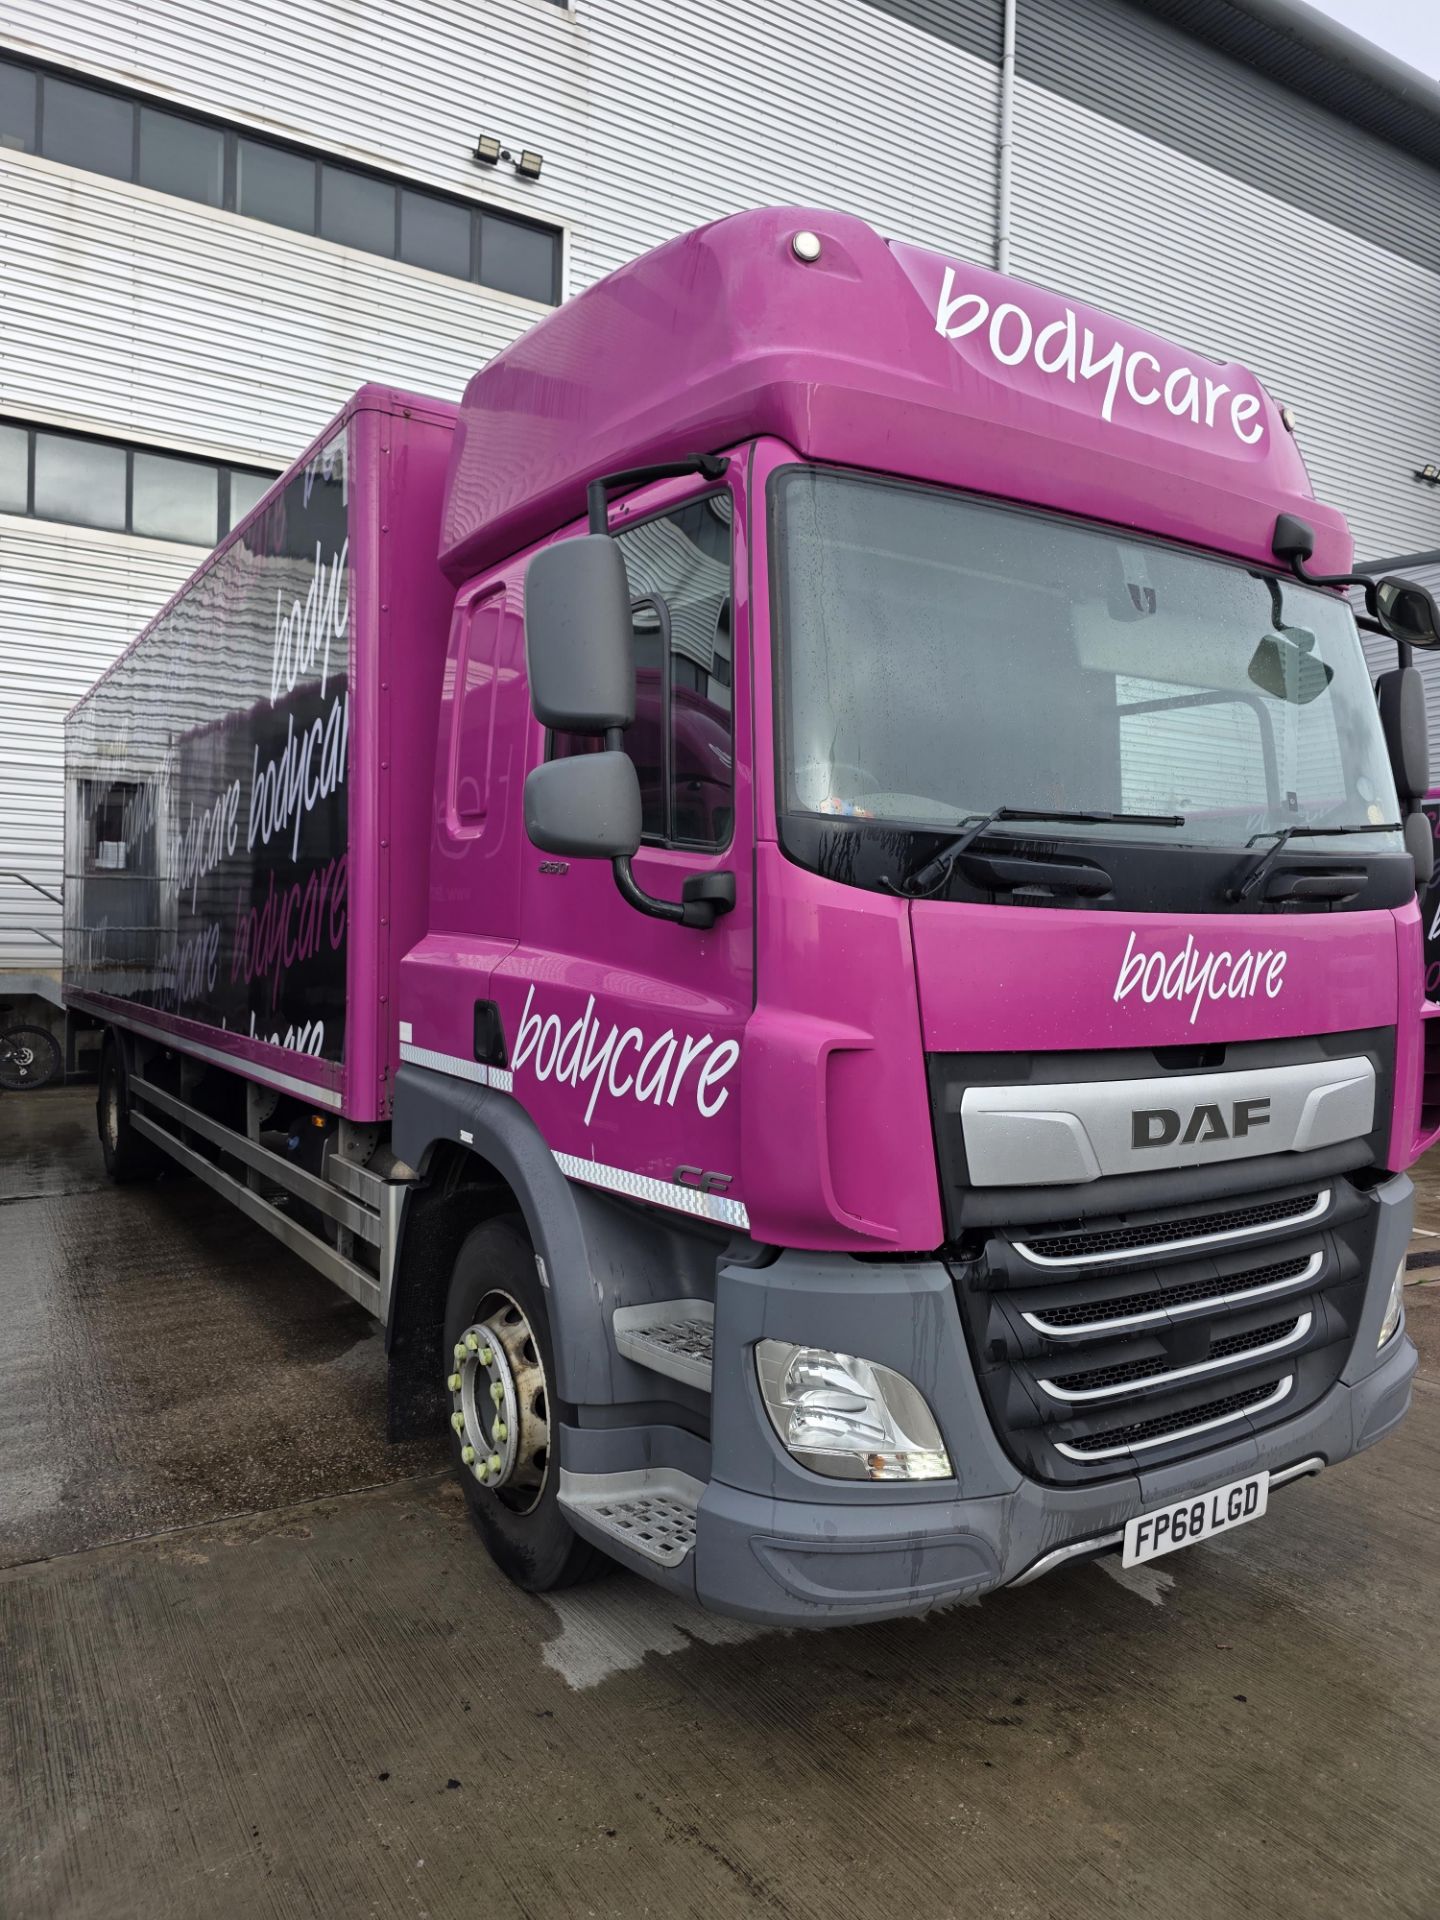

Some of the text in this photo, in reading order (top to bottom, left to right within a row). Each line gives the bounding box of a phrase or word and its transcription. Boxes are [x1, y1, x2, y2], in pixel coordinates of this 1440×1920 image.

[935, 266, 1264, 444] bodycare
[231, 853, 348, 1012] bodycare
[1113, 931, 1287, 1025] bodycare
[511, 983, 739, 1126] bodycare
[1131, 1096, 1271, 1150] DAF
[673, 1164, 733, 1193] CF
[1135, 1481, 1258, 1557] FP68 LGD
